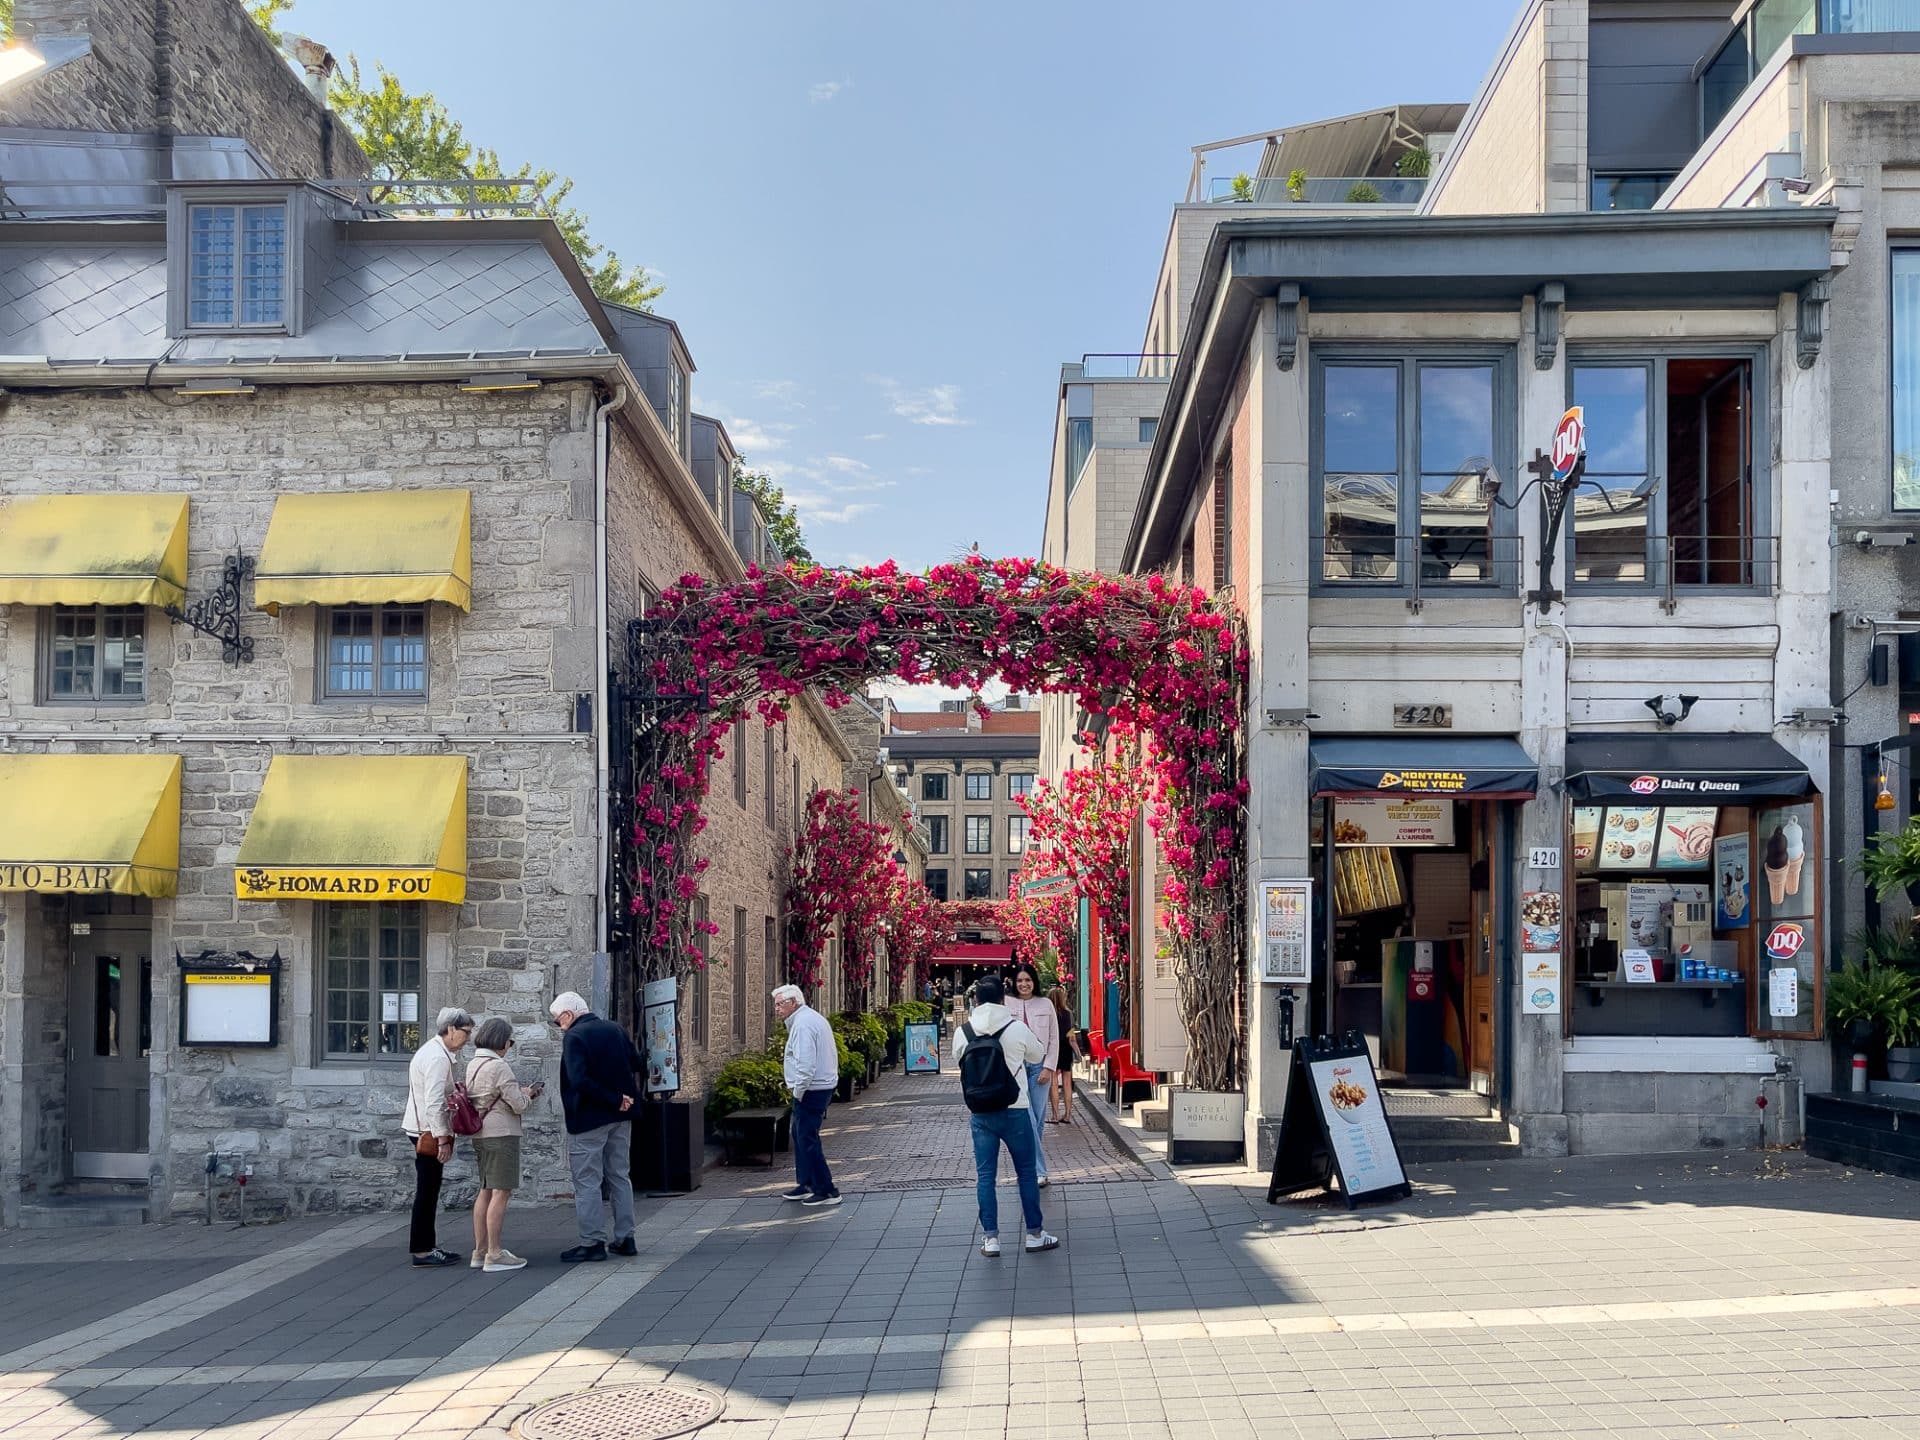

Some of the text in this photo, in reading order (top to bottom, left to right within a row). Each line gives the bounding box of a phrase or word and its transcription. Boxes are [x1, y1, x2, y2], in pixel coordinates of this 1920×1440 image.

[1556, 421, 1578, 467] DQ
[1401, 706, 1445, 725] 420
[1401, 772, 1467, 780] MONTREAL
[1403, 780, 1464, 789] NEW YORK
[1661, 779, 1695, 791] Dairy
[1699, 780, 1740, 791] Queen
[1532, 851, 1556, 865] 420
[0, 865, 112, 889] TO-BAR
[278, 877, 431, 893] HOMARD FOU
[1773, 931, 1797, 950] DQ
[911, 1039, 924, 1051] ICI
